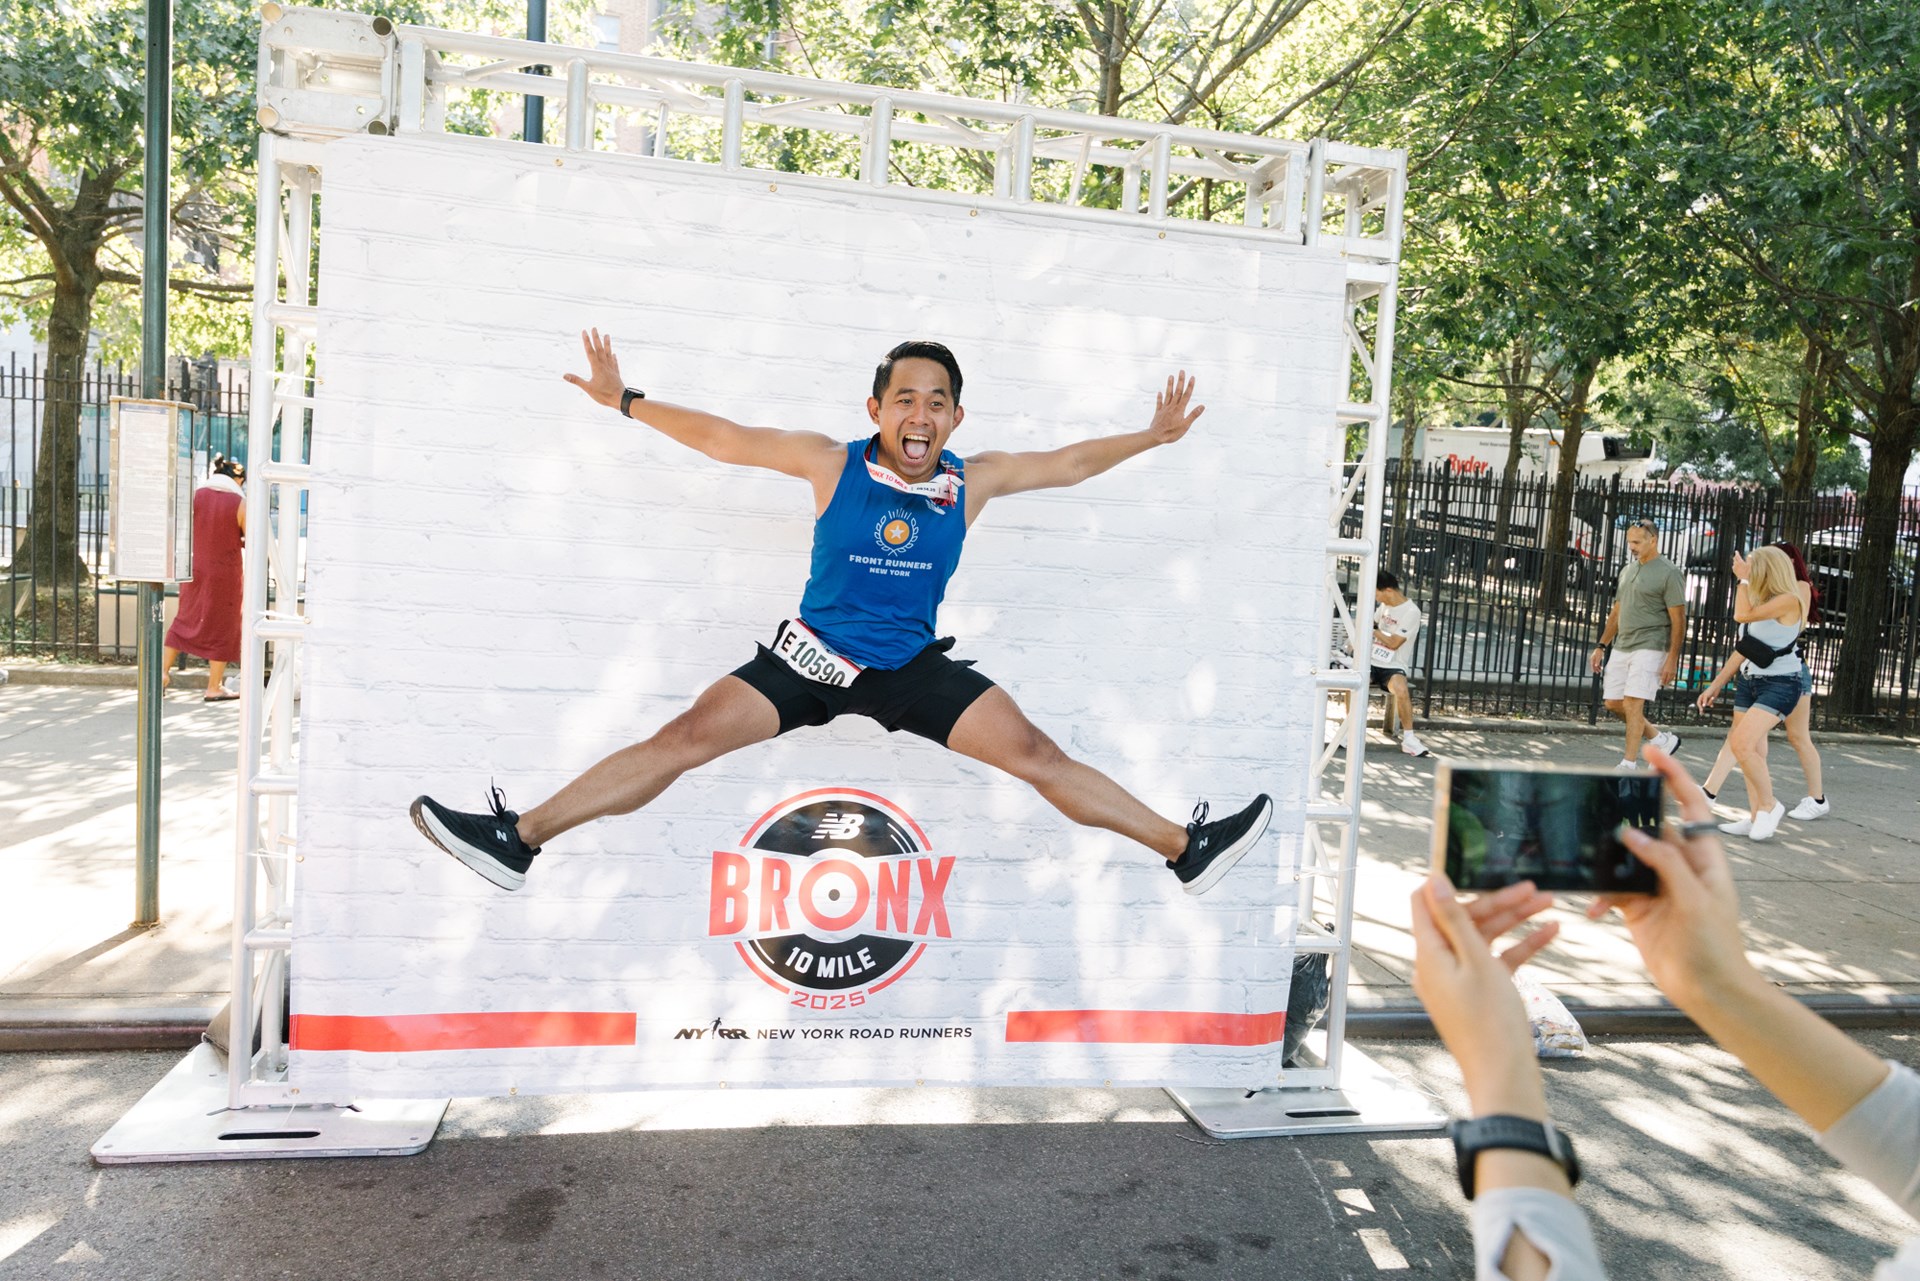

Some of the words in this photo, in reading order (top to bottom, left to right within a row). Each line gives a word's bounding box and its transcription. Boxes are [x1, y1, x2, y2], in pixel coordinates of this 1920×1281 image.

[1448, 453, 1488, 476] Ryder
[849, 554, 883, 566] FRONT
[885, 559, 933, 570] RUNNERS
[869, 567, 888, 575] NEW
[890, 569, 911, 577] YORK
[790, 641, 846, 687] 10590
[708, 851, 957, 939] BRONX
[785, 946, 814, 974] 10
[816, 946, 877, 979] MILE
[790, 990, 866, 1010] 2025
[757, 1028, 796, 1039] NEW
[801, 1028, 844, 1039] YORK
[849, 1028, 894, 1039] ROAD
[899, 1027, 972, 1039] RUNNERS
